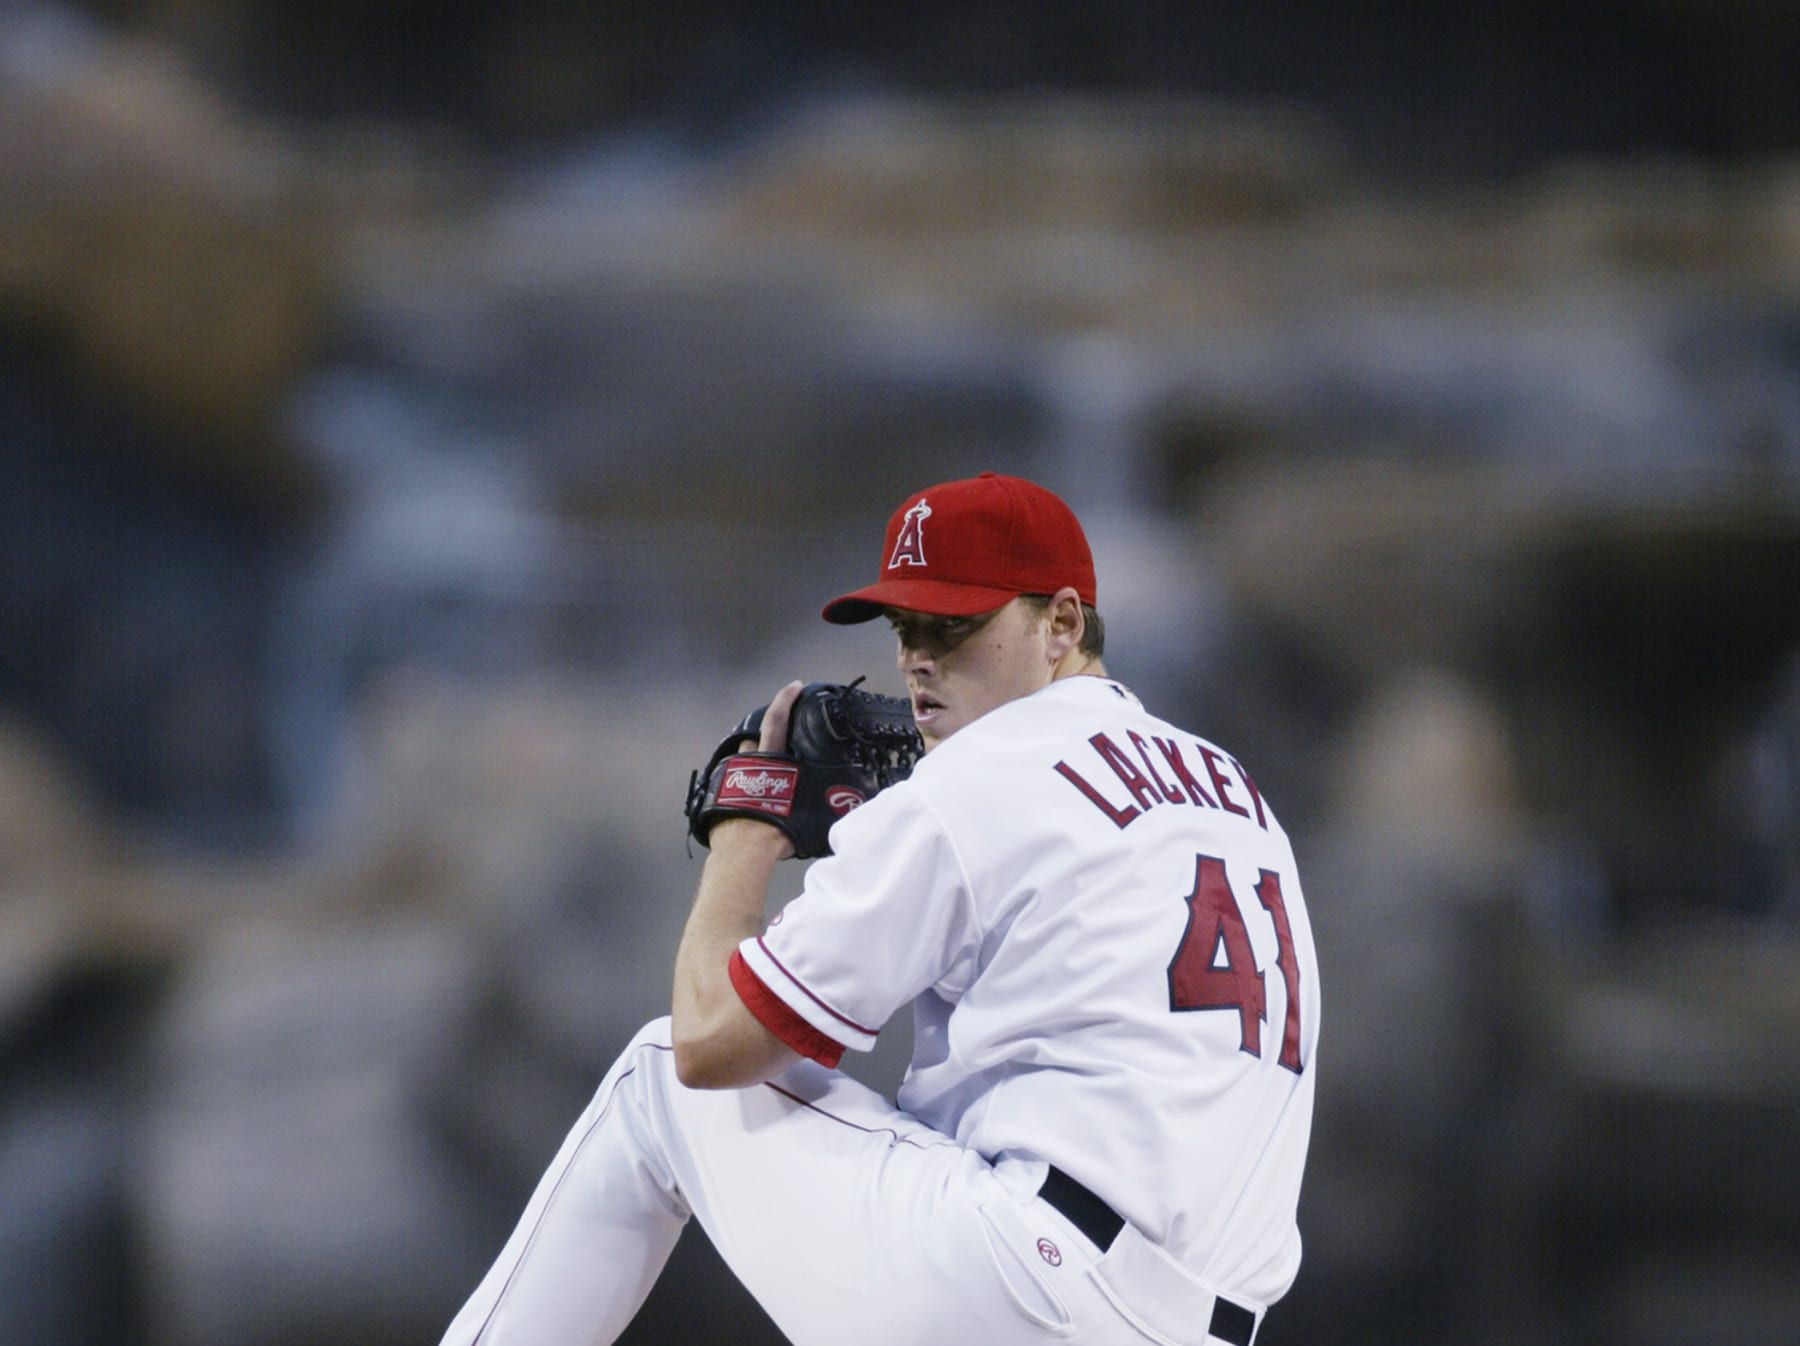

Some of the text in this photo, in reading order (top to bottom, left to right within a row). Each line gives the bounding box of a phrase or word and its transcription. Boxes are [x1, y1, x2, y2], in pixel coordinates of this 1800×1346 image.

[888, 498, 932, 570] A
[726, 770, 790, 797] Rawlings
[1167, 852, 1304, 1076] 41
